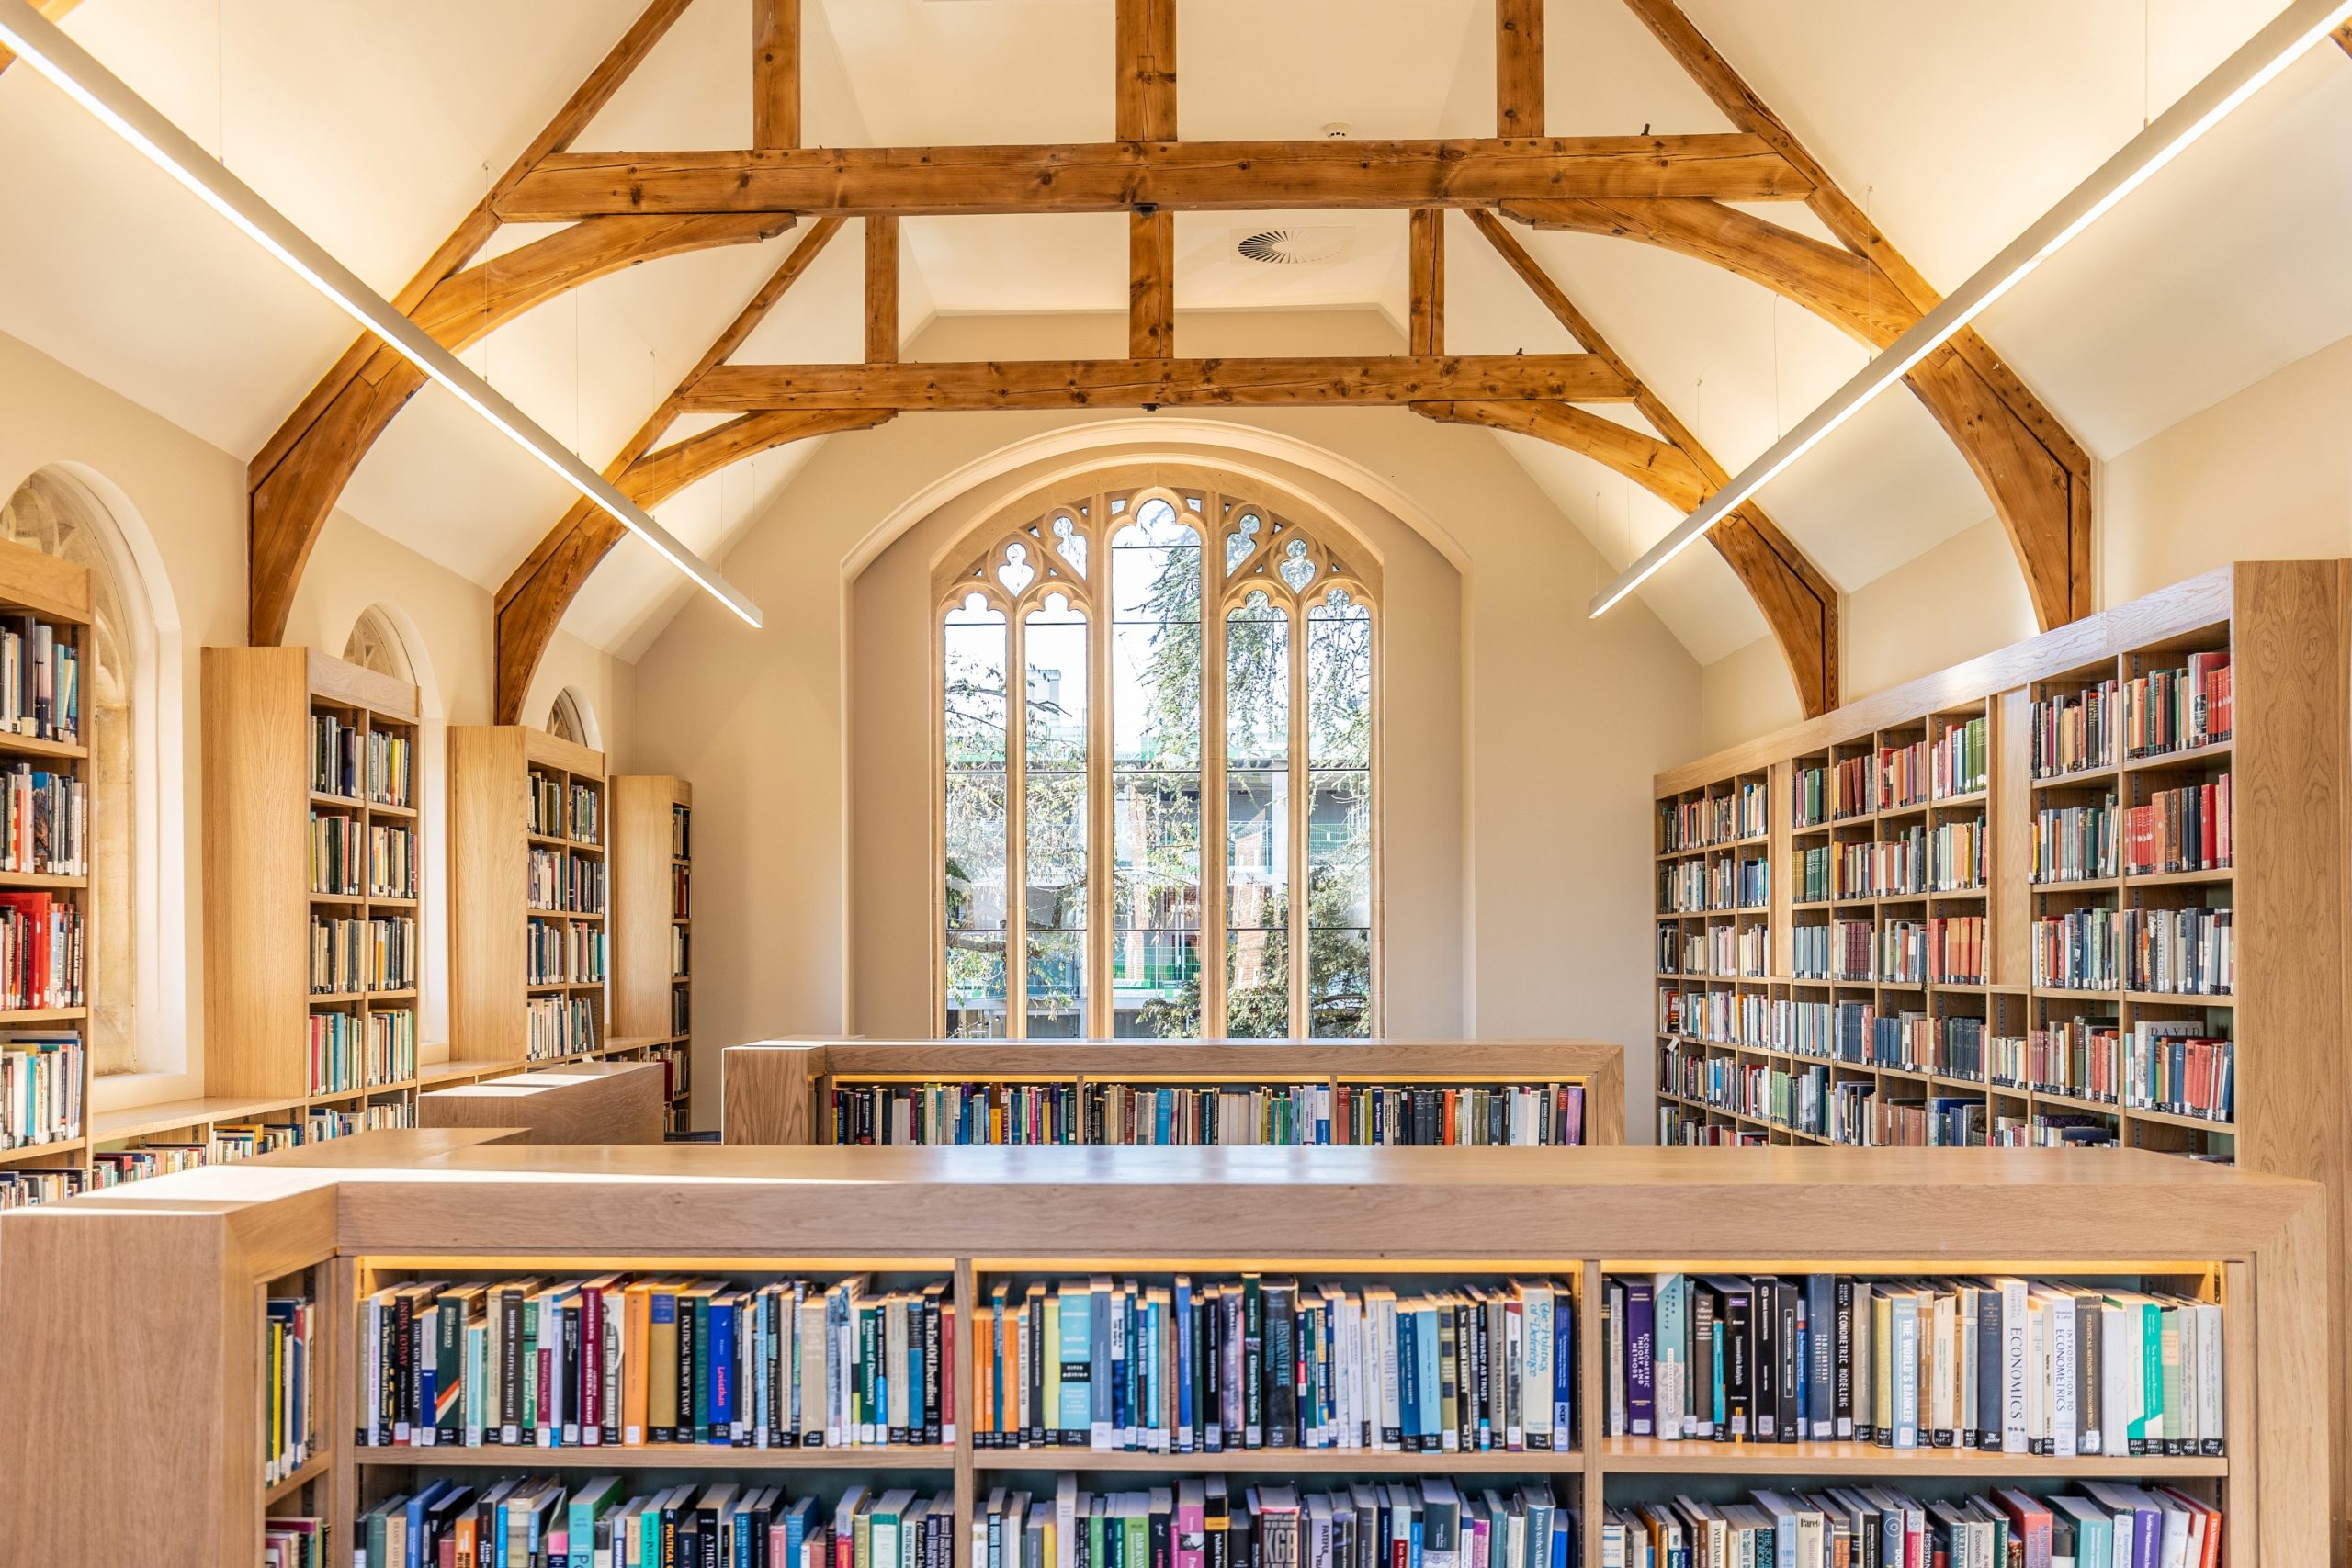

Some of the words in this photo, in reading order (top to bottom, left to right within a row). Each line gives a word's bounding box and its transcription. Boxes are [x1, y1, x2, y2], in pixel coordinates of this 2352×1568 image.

[2150, 1027, 2201, 1036] DAVID
[400, 1302, 408, 1330] INDIA
[926, 1315, 939, 1328] The
[1527, 1304, 1539, 1314] of
[1539, 1301, 1551, 1322] The
[381, 1326, 390, 1336] The
[413, 1324, 421, 1344] DAHL
[507, 1310, 515, 1338] MODERN
[681, 1315, 691, 1355] POLITICAL
[866, 1320, 875, 1351] Patterns
[1460, 1327, 1468, 1347] MILL
[1839, 1311, 1849, 1363] ECONOMETRIC
[1903, 1319, 1914, 1337] THE
[381, 1337, 390, 1355] Terms
[400, 1334, 408, 1366] TODAY
[606, 1336, 616, 1348] THE
[926, 1330, 939, 1348] End
[1539, 1325, 1551, 1372] Politics
[413, 1348, 421, 1359] ON
[507, 1342, 515, 1380] POLITICAL
[926, 1348, 939, 1359] Of
[1384, 1349, 1396, 1374] GENDER
[1460, 1348, 1468, 1359] ON
[1903, 1339, 1914, 1382] WORLD'S
[381, 1363, 390, 1386] Political
[606, 1376, 616, 1385] OF
[681, 1358, 691, 1386] THEORY
[866, 1363, 875, 1405] Democracy
[926, 1359, 939, 1406] Liberalism
[1249, 1355, 1257, 1394] Citizenship
[1460, 1361, 1468, 1393] LIBERTY
[1480, 1365, 1487, 1376] AS
[2010, 1327, 2022, 1419] ECONOMICS
[2056, 1329, 2065, 1412] ECONOMETRICS
[413, 1362, 421, 1408] DEMOCRACY
[718, 1366, 727, 1406] Leviathan
[1384, 1377, 1396, 1403] STUDIES
[1839, 1368, 1849, 1407] MODELING
[381, 1387, 390, 1416] Discourse
[507, 1384, 515, 1417] THOUGHT
[606, 1387, 616, 1427] LIBERALISM
[681, 1387, 691, 1416] TODAY
[1249, 1396, 1257, 1422] Studies
[1903, 1384, 1914, 1422] BANKER
[2067, 1401, 2073, 1411] TO
[1535, 1512, 1545, 1530] Envoy
[1742, 1529, 1750, 1539] The
[665, 1523, 674, 1563] POLITICAL
[905, 1525, 913, 1554] POLITICS
[1264, 1529, 1298, 1563] KGB
[1742, 1540, 1751, 1556] Spirit
